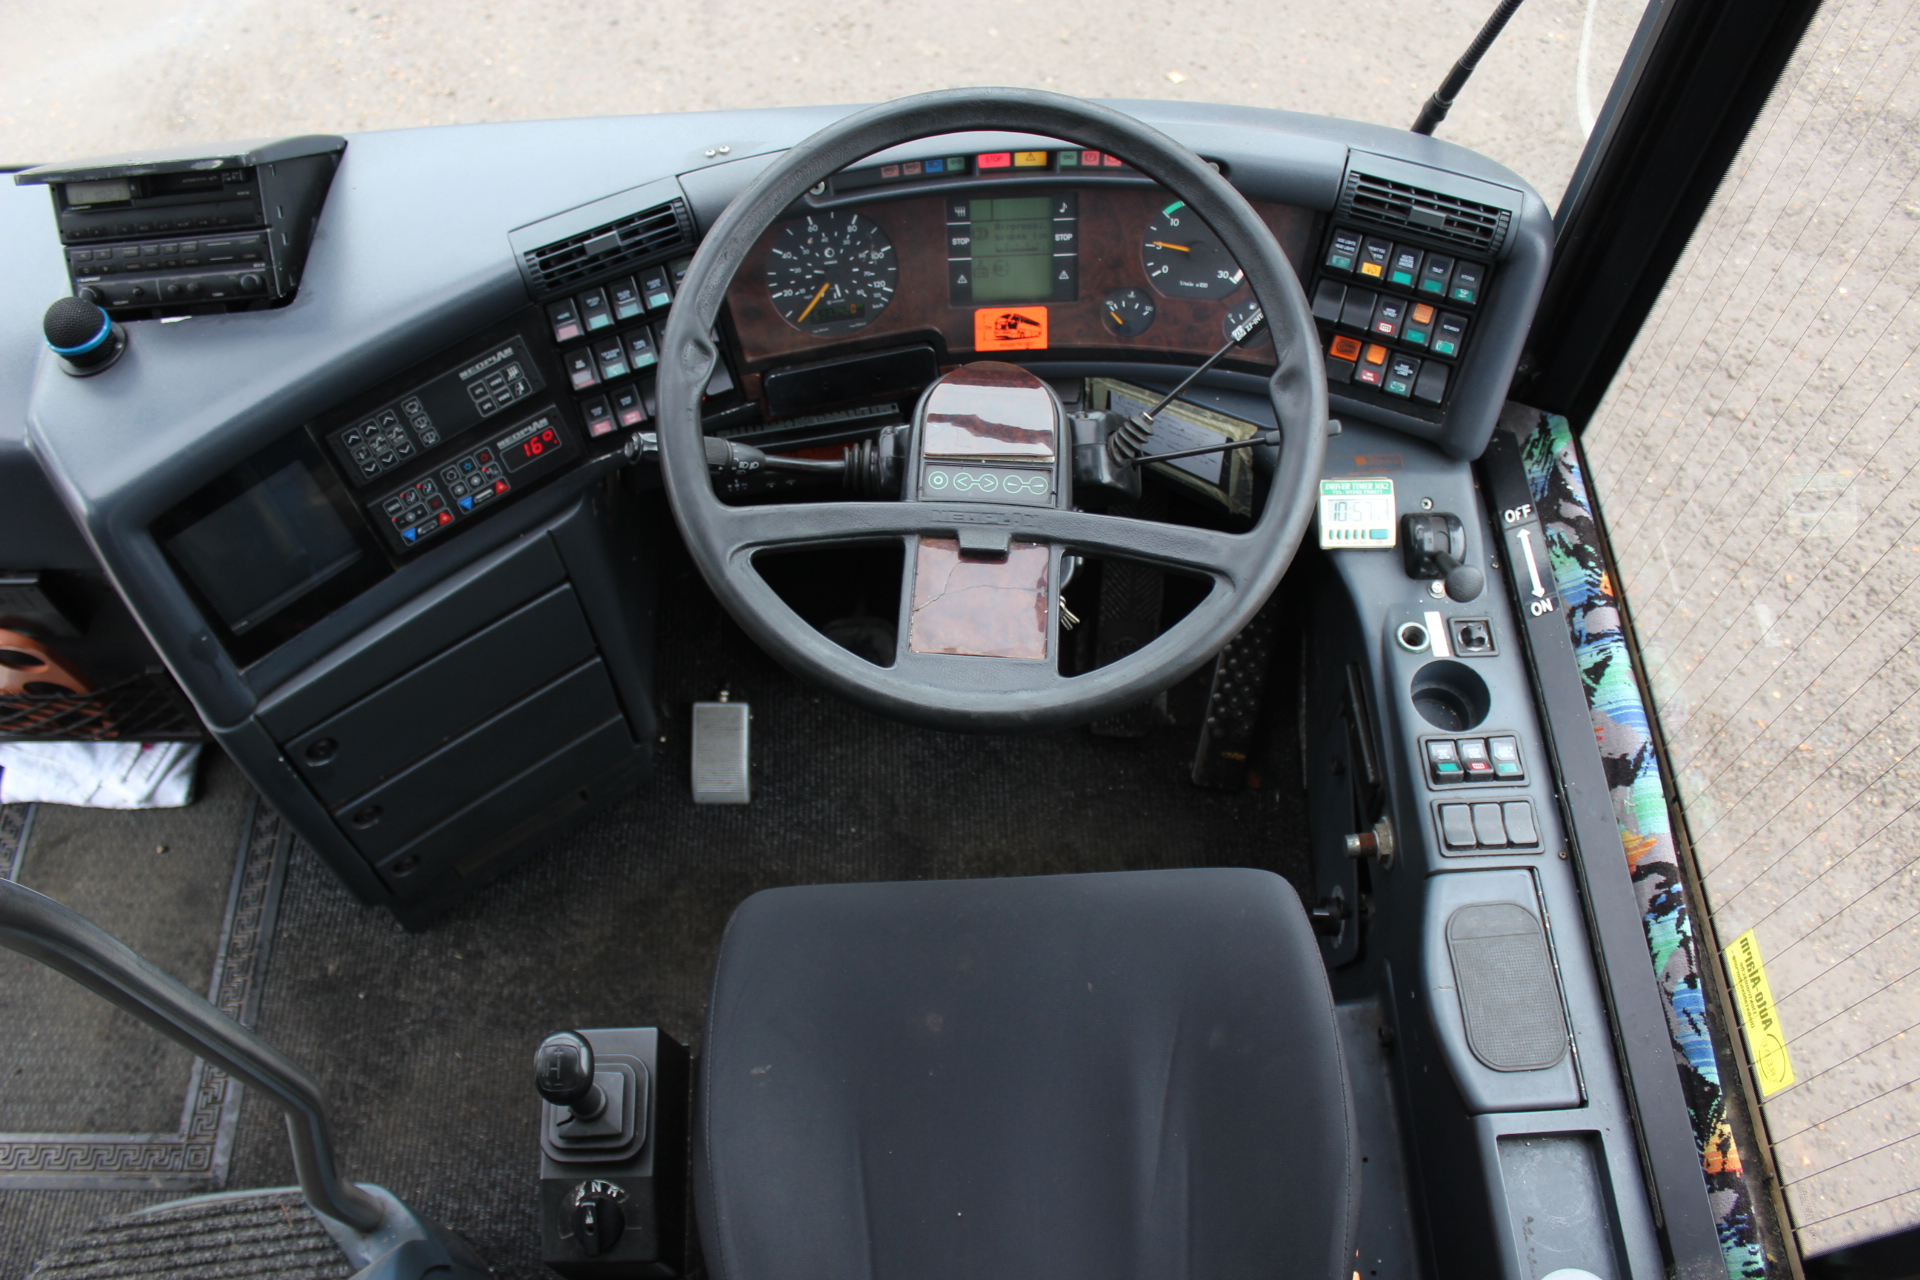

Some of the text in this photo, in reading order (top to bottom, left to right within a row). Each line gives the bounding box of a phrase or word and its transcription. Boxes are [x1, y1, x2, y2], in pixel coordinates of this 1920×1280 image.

[985, 155, 1003, 163] STOP
[1170, 218, 1180, 227] 10
[807, 224, 819, 233] 60
[847, 225, 858, 233] 80
[952, 237, 970, 246] STOP
[1055, 233, 1073, 241] STOP
[781, 251, 792, 259] 40
[870, 252, 885, 260] 100
[1162, 265, 1169, 274] 0
[1217, 270, 1230, 279] 30
[873, 280, 886, 289] 120
[783, 289, 794, 297] 20
[459, 347, 514, 381] NEOPLAN
[496, 417, 549, 451] NEOPLAN
[1374, 482, 1389, 490] MK2
[1333, 501, 1372, 522] 10:57
[1504, 503, 1531, 523] OFF
[1530, 597, 1554, 617] ON
[591, 1181, 602, 1193] N
